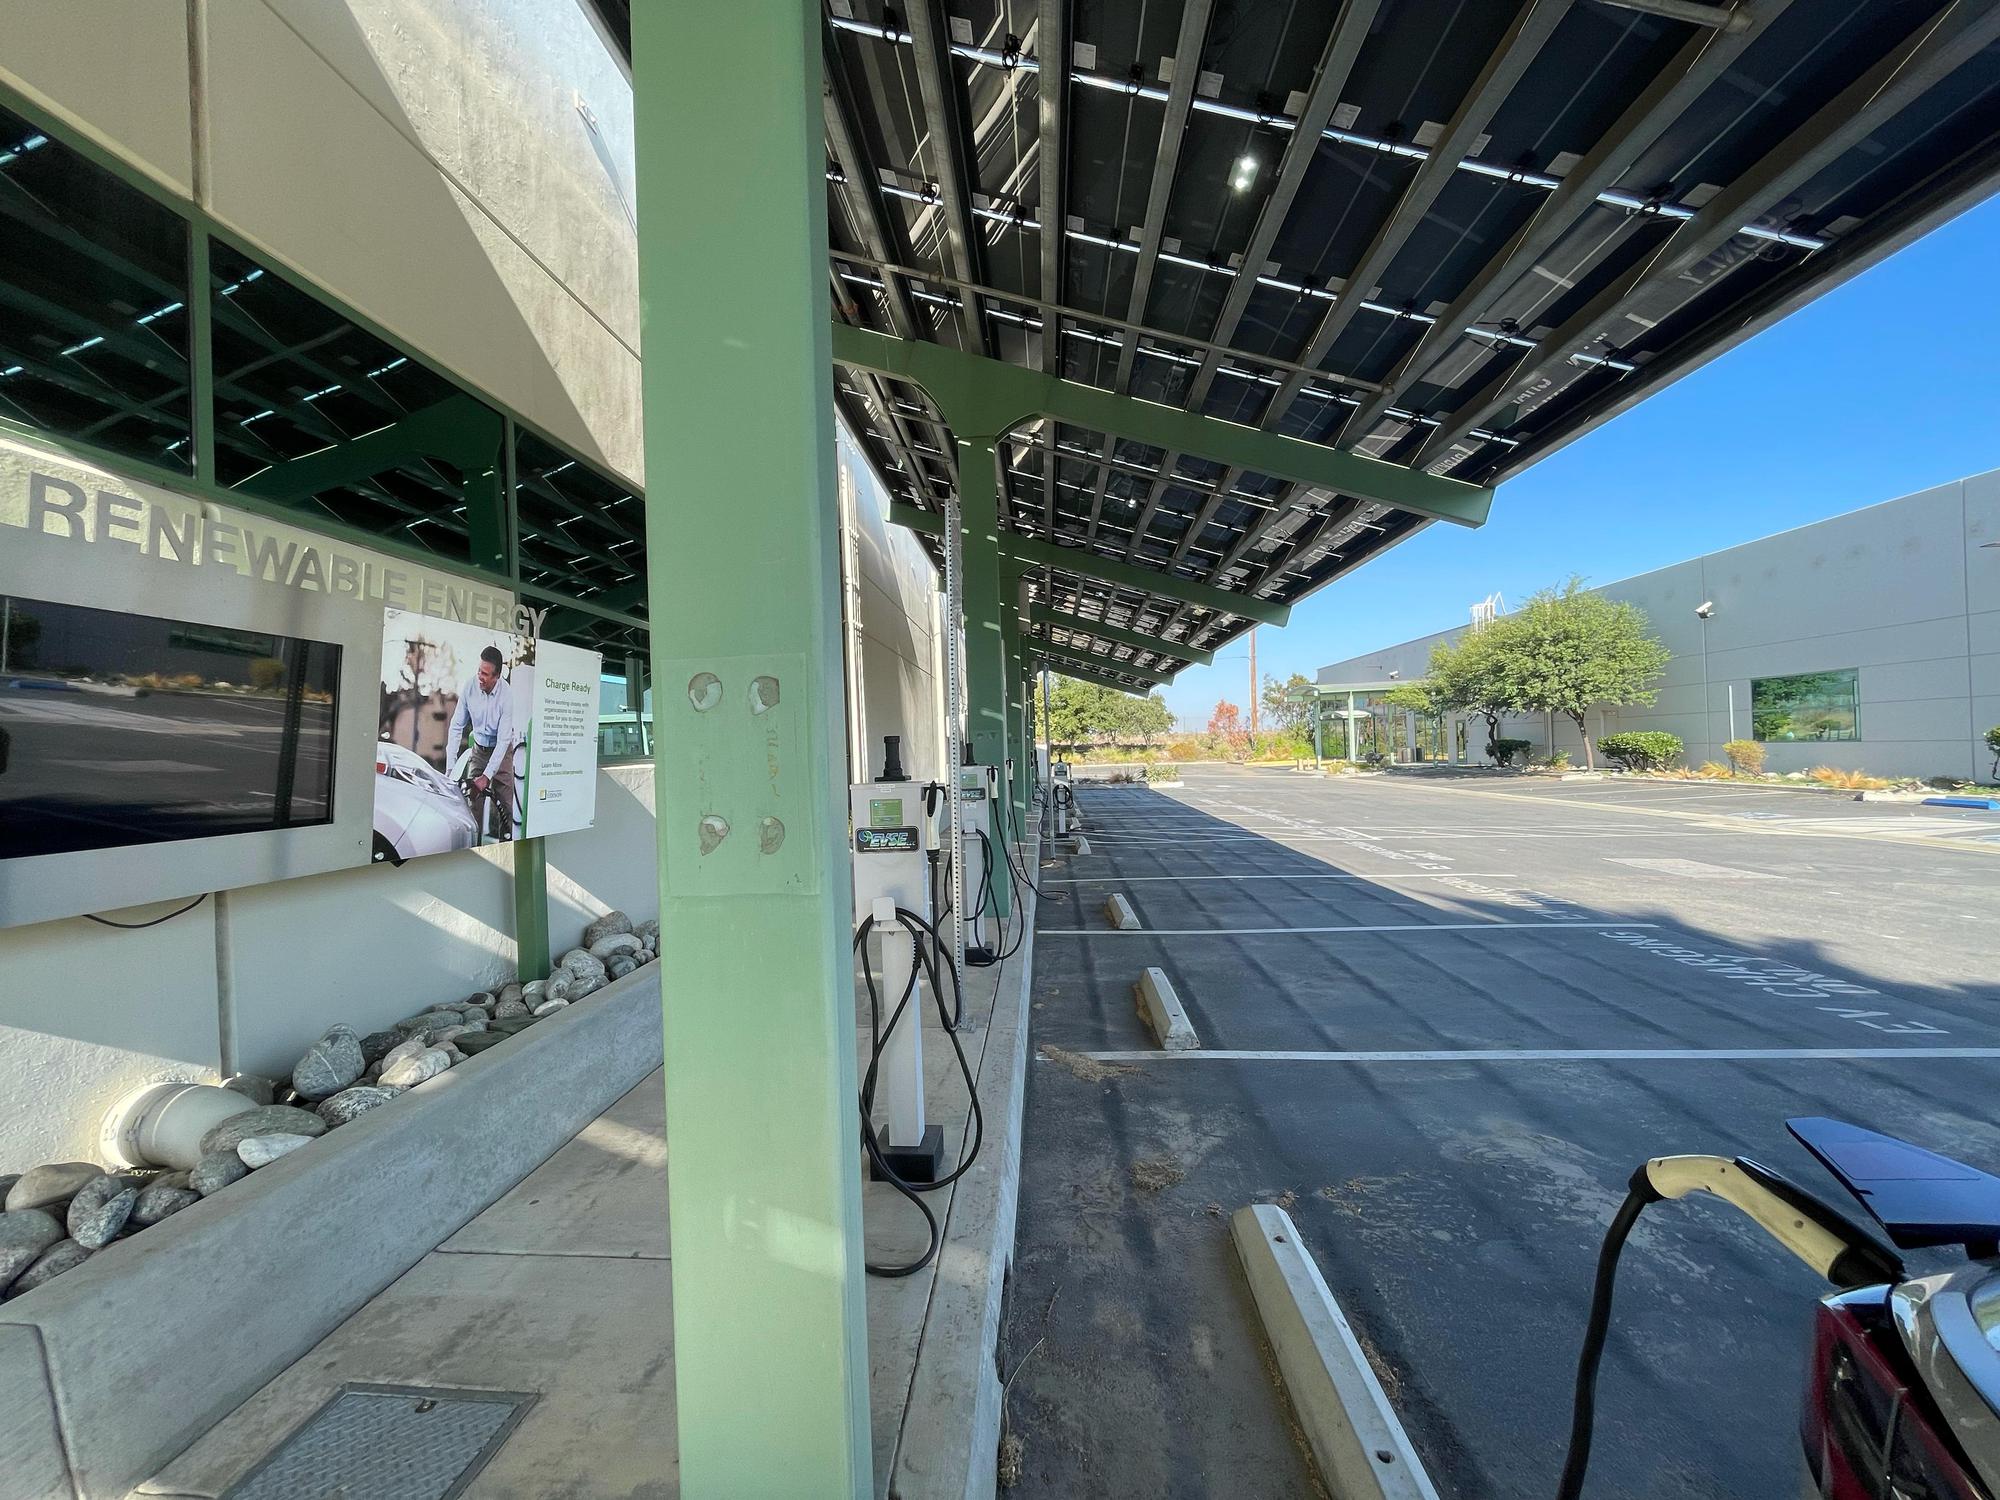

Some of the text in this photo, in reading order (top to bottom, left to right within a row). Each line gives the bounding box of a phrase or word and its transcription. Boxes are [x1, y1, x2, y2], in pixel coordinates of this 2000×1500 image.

[28, 471, 547, 639] RENEWABLE ENERGY
[545, 678, 591, 694] Charge Ready
[1598, 930, 1831, 998] CHARGING
